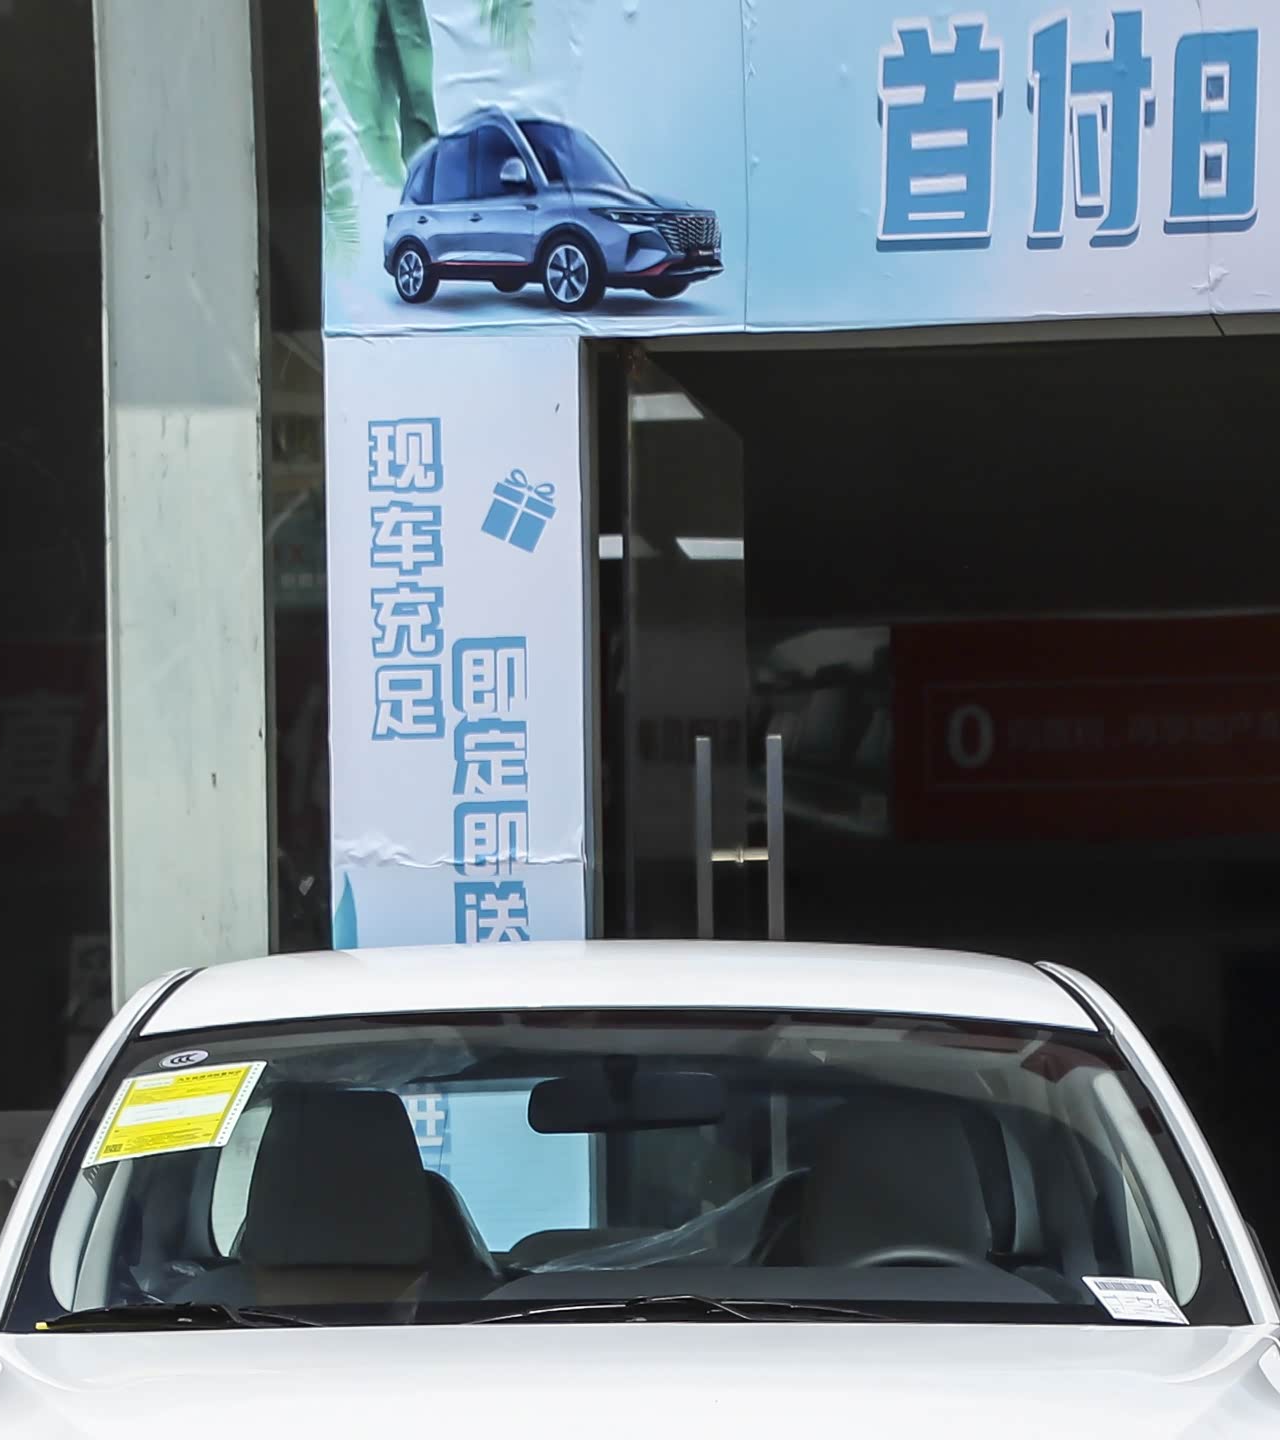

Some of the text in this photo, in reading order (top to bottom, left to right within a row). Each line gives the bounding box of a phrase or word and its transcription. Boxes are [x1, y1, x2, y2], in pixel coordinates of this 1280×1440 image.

[368, 417, 446, 742] 现车充足
[452, 636, 531, 944] 即定即送
